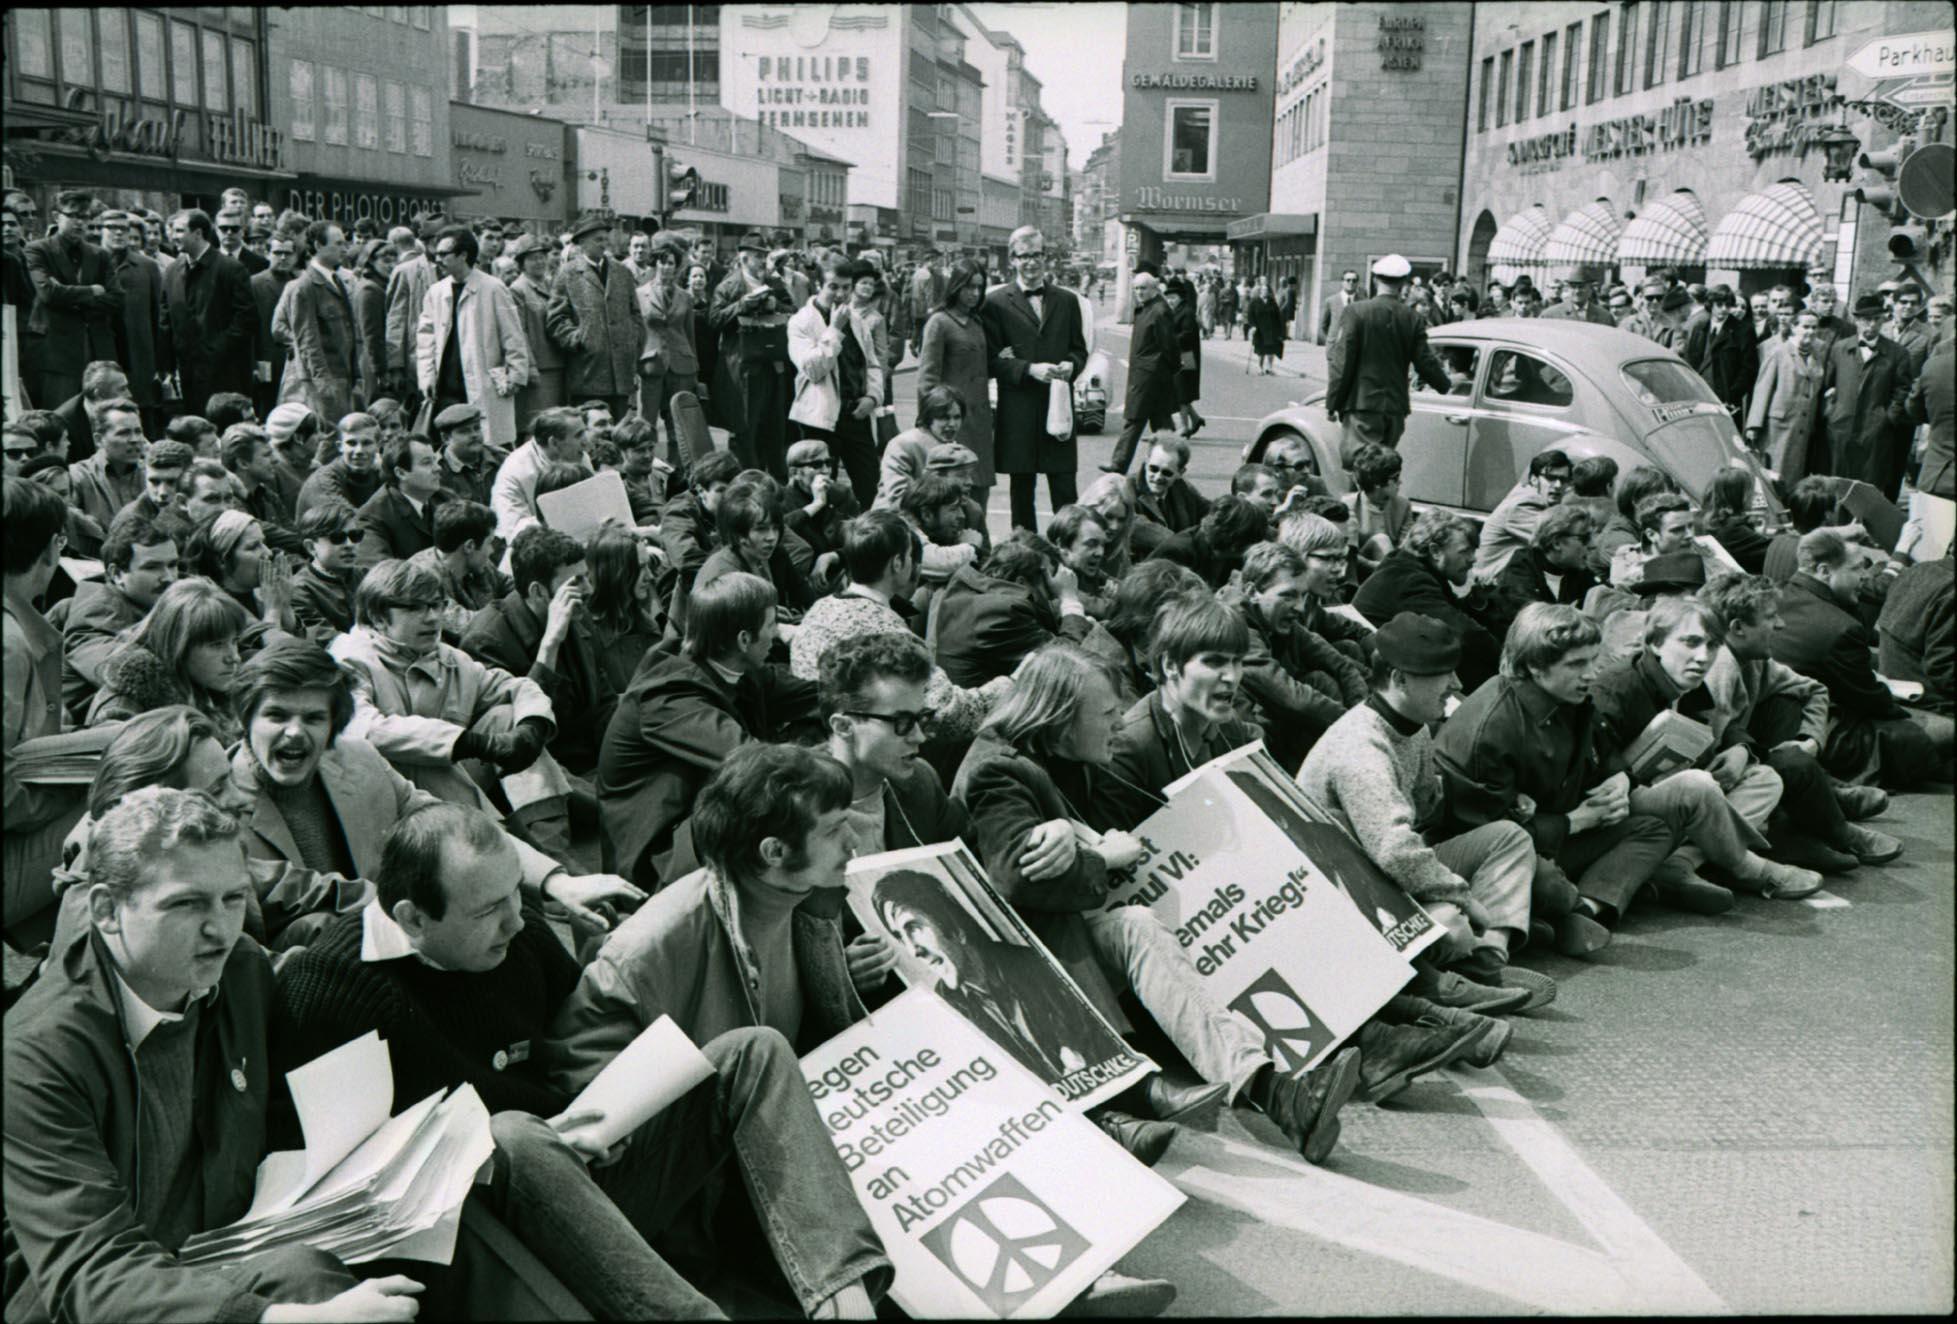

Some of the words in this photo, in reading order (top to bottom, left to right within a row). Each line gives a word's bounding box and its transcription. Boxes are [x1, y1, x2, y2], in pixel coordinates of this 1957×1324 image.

[758, 57, 869, 82] PHILIPS
[1879, 43, 1955, 67] Parkhau
[758, 88, 802, 105] LICHT
[1131, 73, 1258, 90] GEMÄLDEGALERIE
[758, 111, 868, 128] FERNSEHEN
[289, 189, 327, 222] DER
[332, 193, 393, 224] PHOTO
[1107, 836, 1161, 890] apst
[1157, 850, 1200, 881] VI:
[1175, 883, 1246, 948] emals
[1385, 913, 1430, 948] TSCHKE
[1196, 933, 1237, 977] ehr
[807, 1045, 880, 1100] egen
[827, 1048, 942, 1134] eutsche
[836, 1056, 999, 1173] Beteiligung
[866, 1165, 911, 1201] an
[891, 1099, 1064, 1234] Atomwaffen
